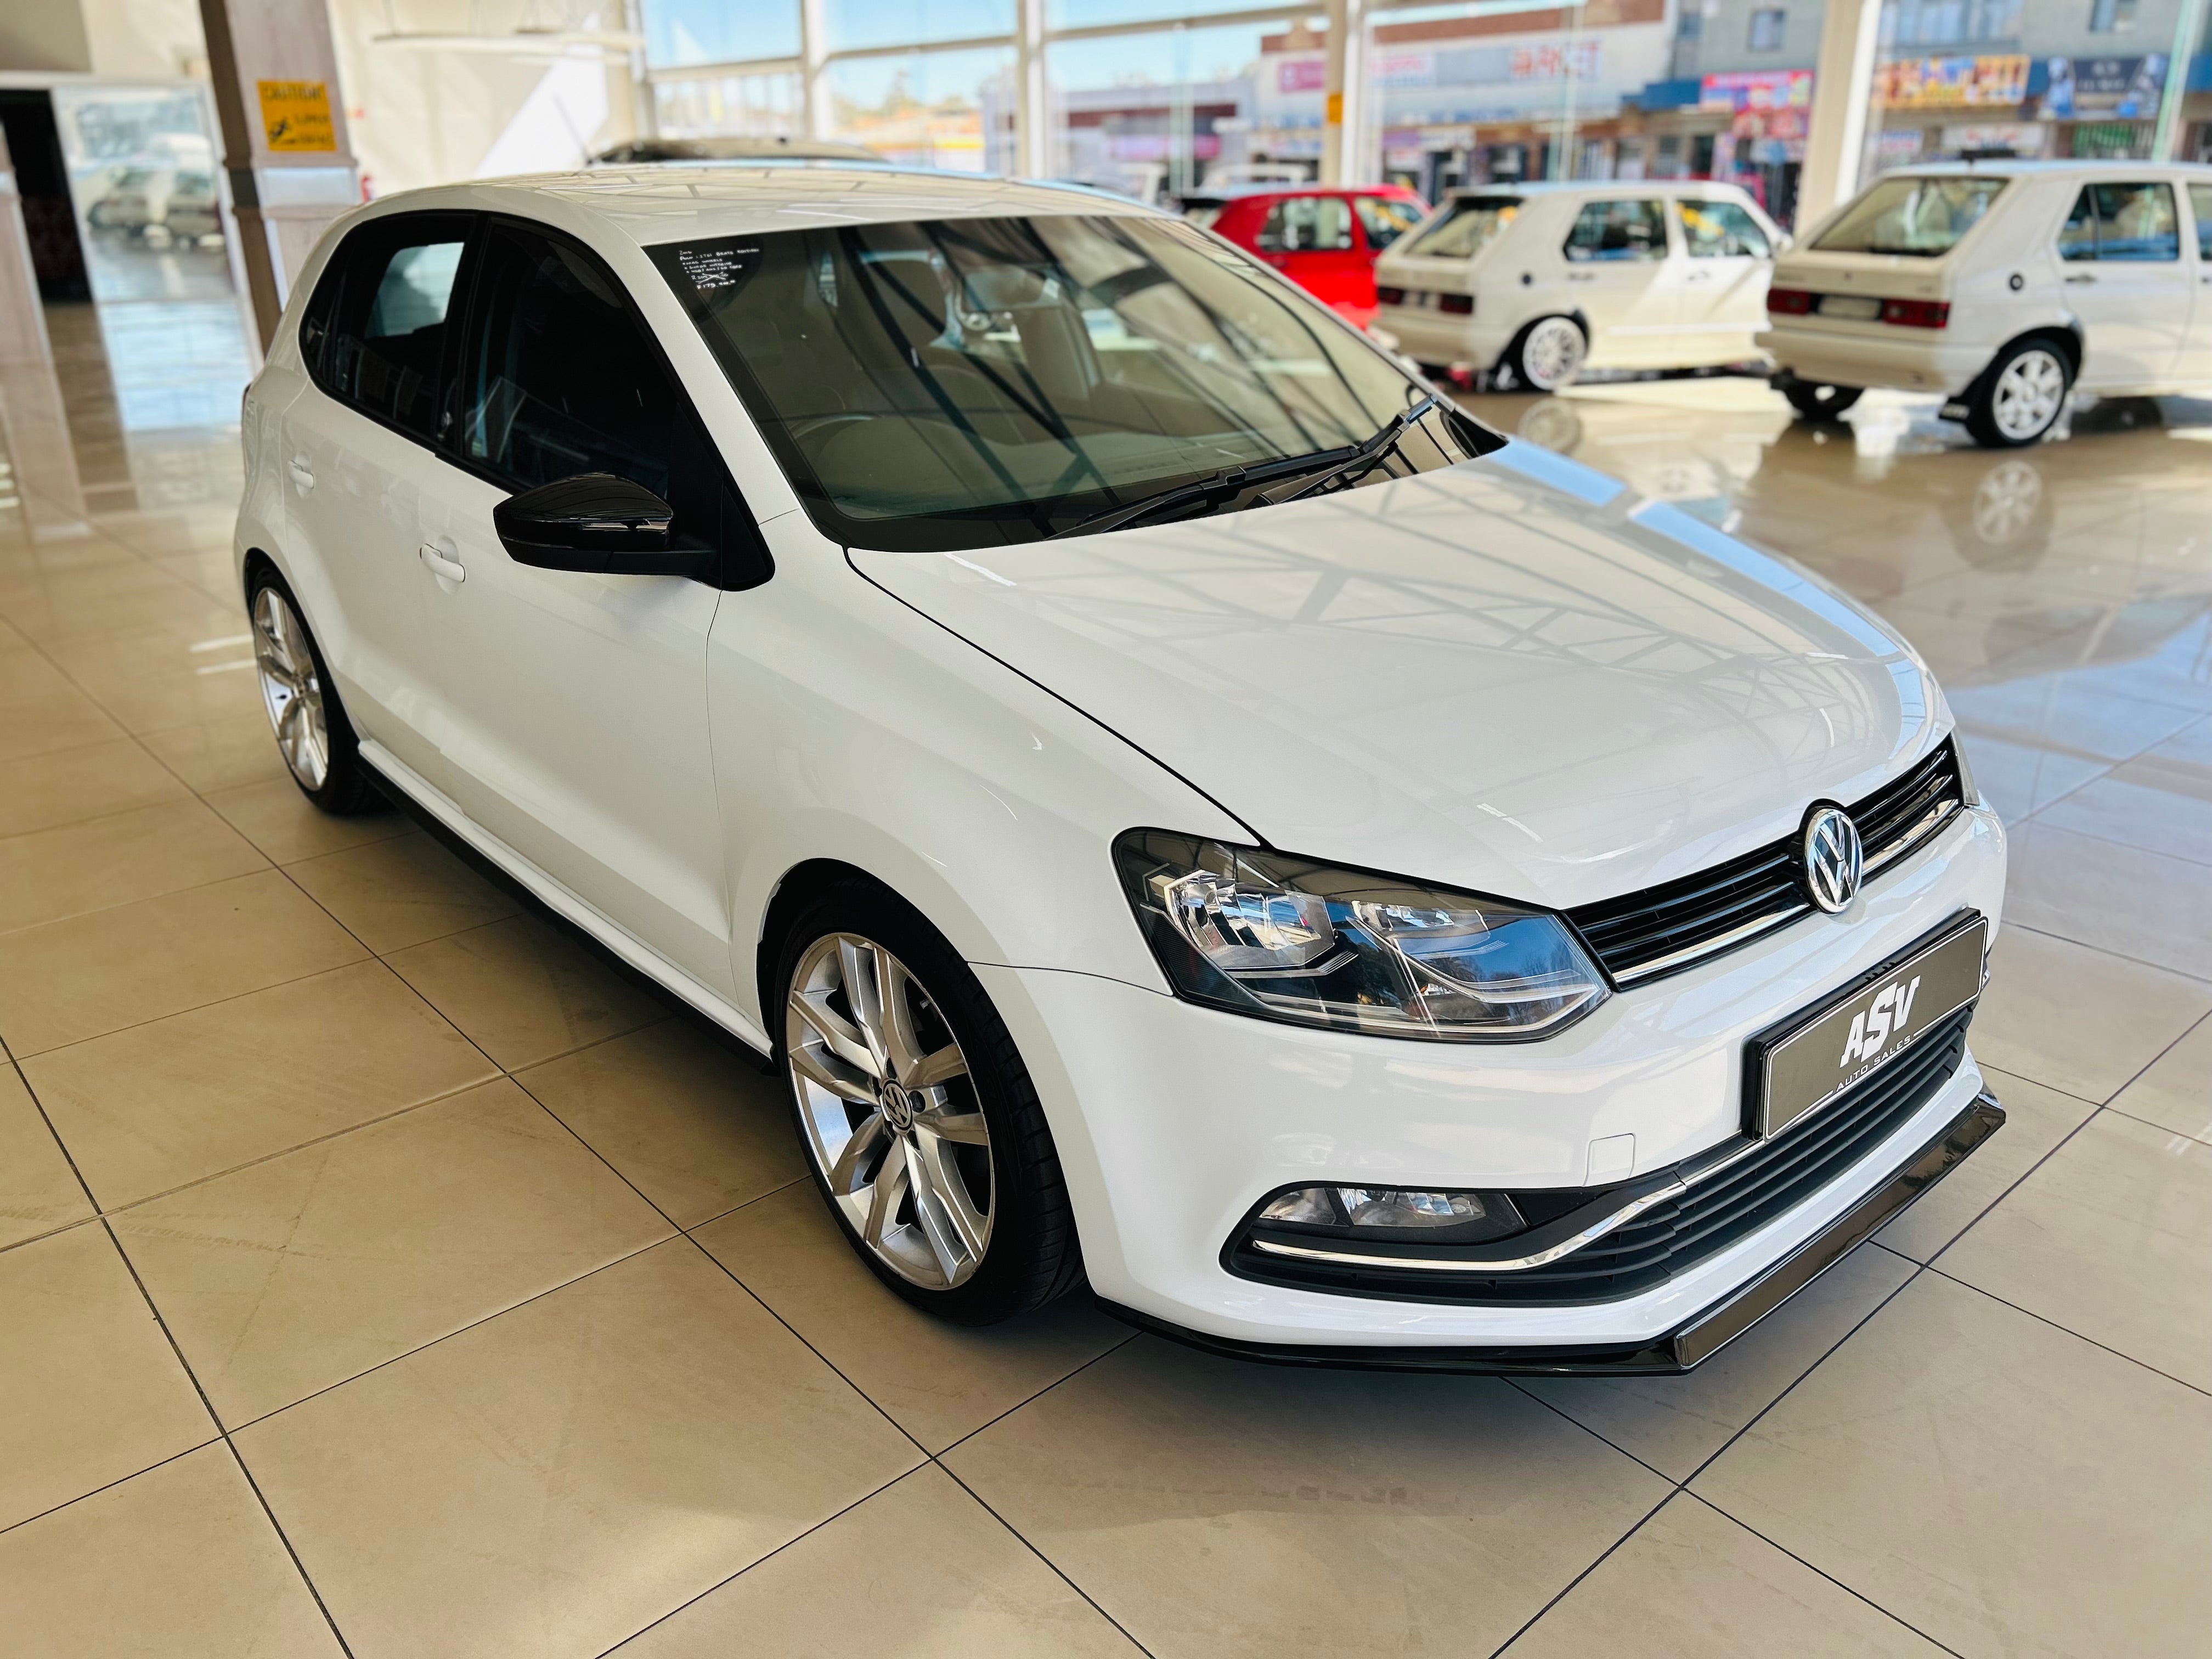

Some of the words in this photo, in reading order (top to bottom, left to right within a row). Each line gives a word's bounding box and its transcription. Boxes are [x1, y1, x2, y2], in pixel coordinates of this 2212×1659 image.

[1807, 811, 1861, 911] VW
[1839, 974, 1921, 1068] ASV
[1836, 1066, 1869, 1093] AUTO
[1874, 1033, 1911, 1067] SALES
[884, 1083, 911, 1127] VW
